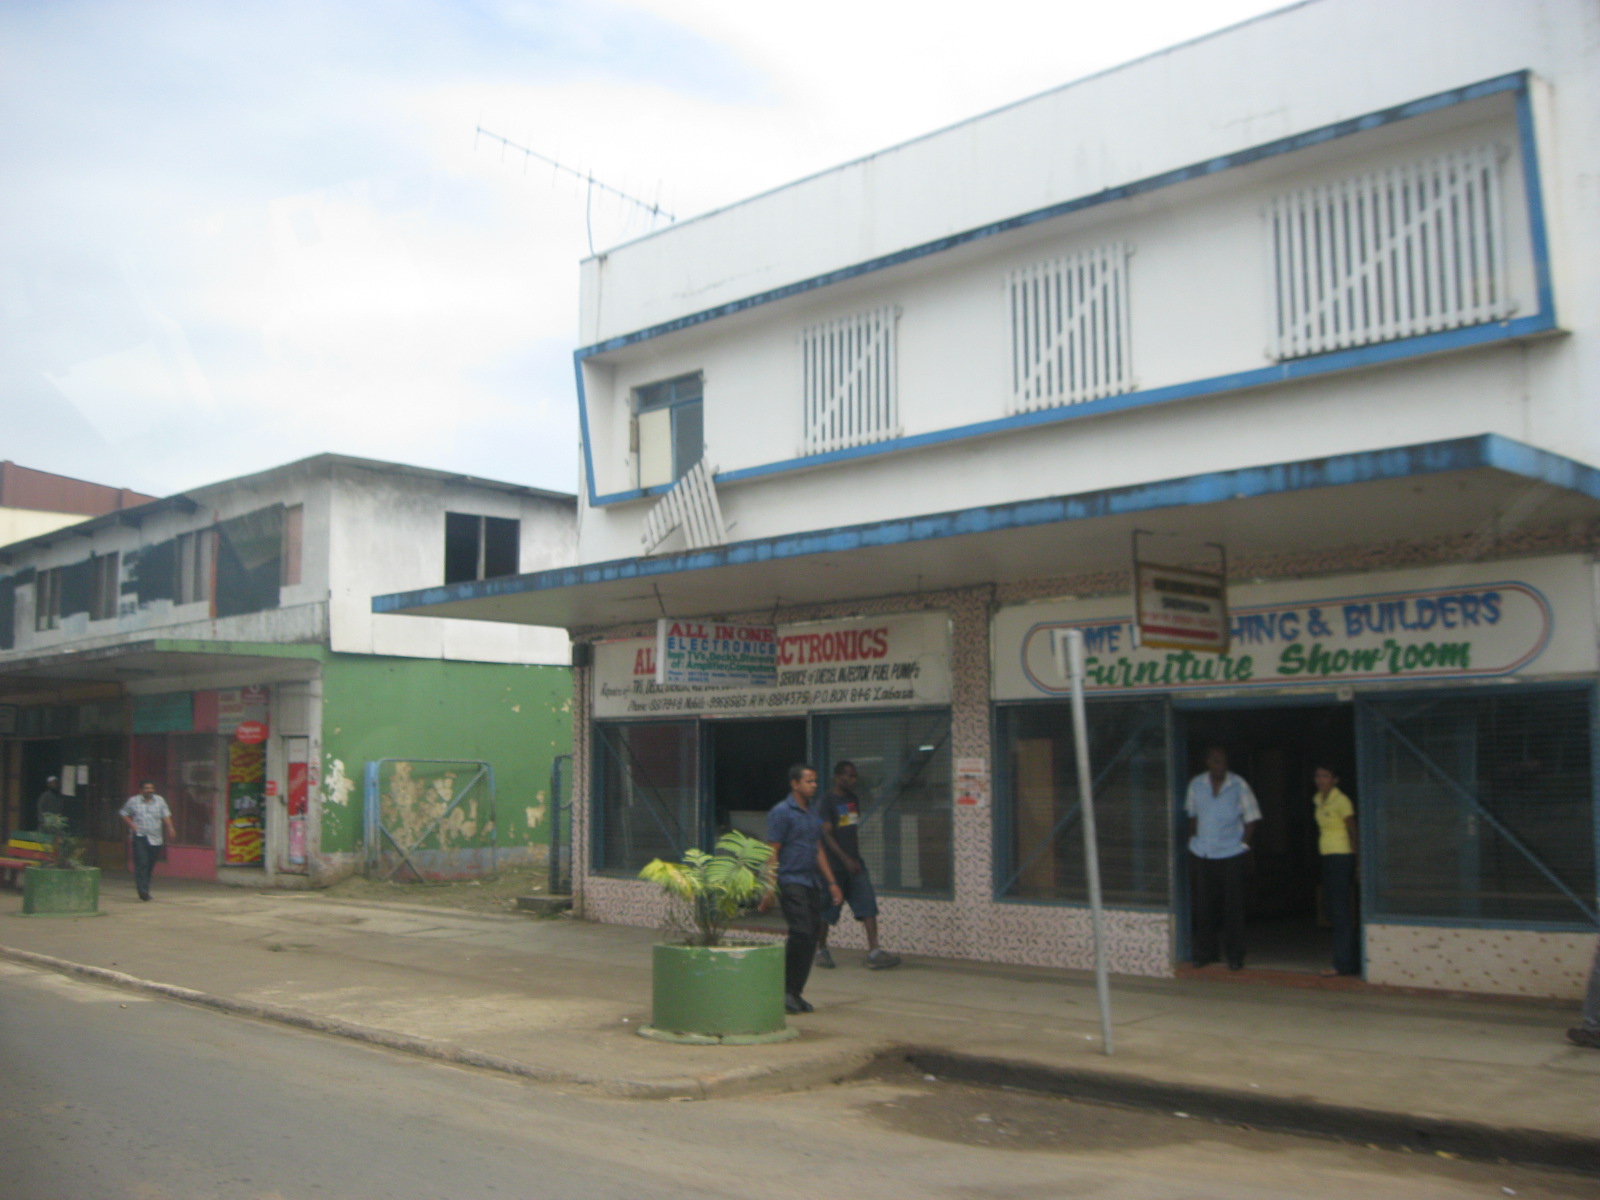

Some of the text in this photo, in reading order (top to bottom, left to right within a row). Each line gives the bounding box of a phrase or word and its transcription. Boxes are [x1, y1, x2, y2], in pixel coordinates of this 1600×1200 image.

[1306, 606, 1333, 638] &
[1343, 591, 1502, 638] BUILDERS
[667, 623, 775, 643] ALL IN ONE
[667, 636, 776, 655] ELECTRONICS
[633, 627, 888, 675] AL CTRONICS
